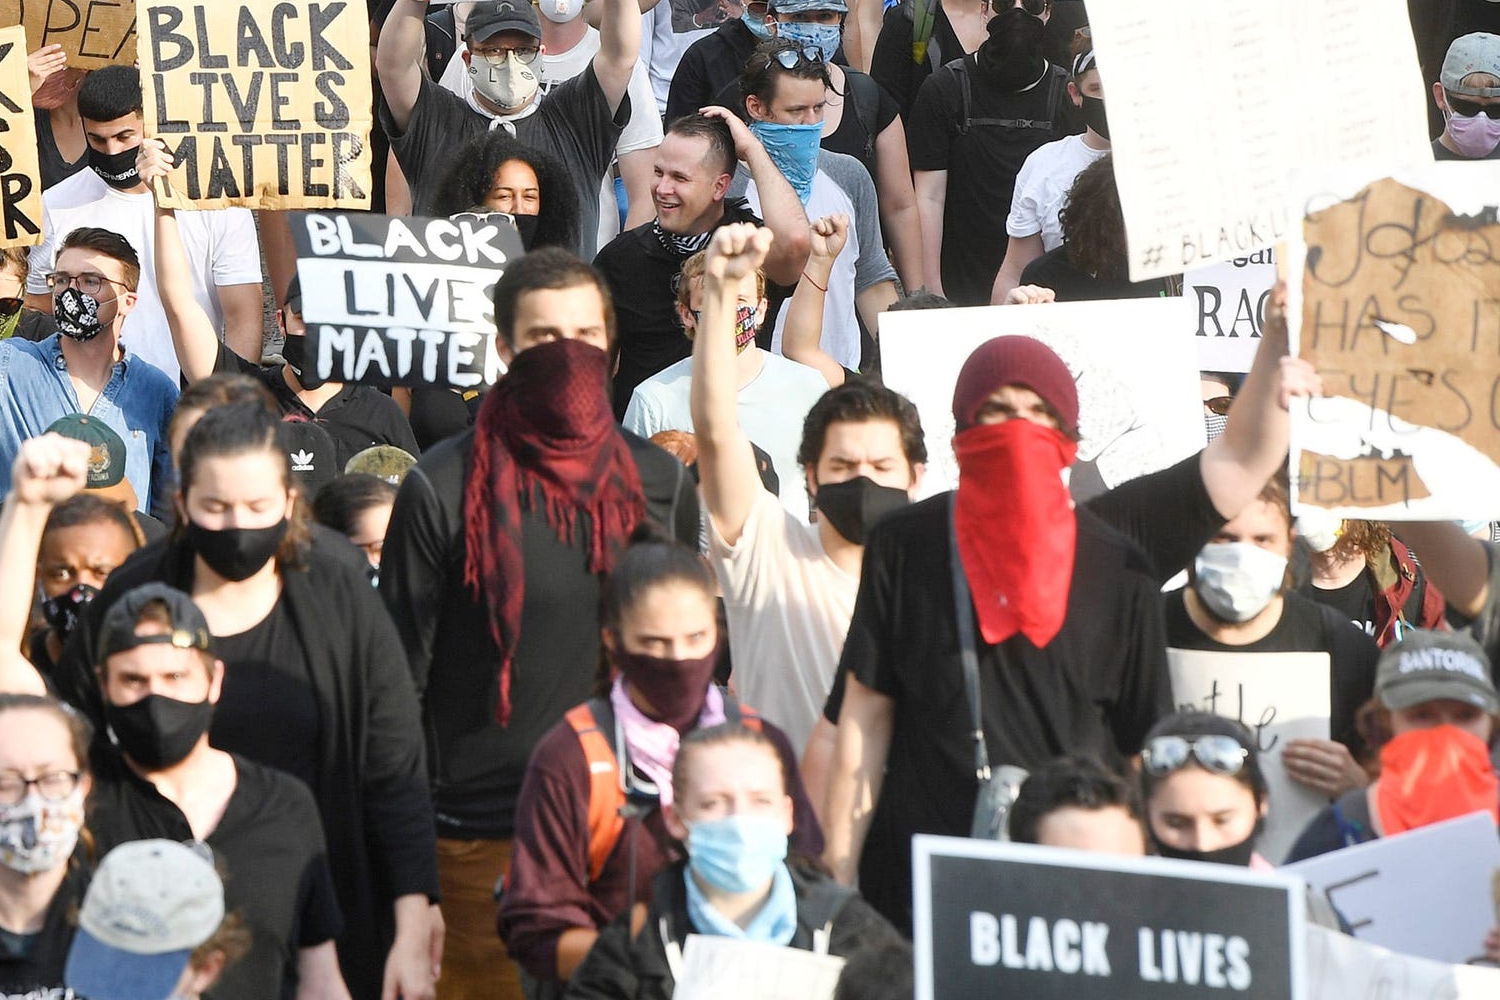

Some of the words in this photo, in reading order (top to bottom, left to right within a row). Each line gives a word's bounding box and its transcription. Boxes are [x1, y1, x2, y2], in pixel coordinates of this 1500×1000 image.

[148, 1, 354, 73] BLACK
[151, 70, 352, 134] LIVES
[156, 133, 367, 201] MATTER
[305, 213, 507, 264] BLACK
[970, 911, 1111, 977] BLACK
[1139, 926, 1252, 992] LIVES
